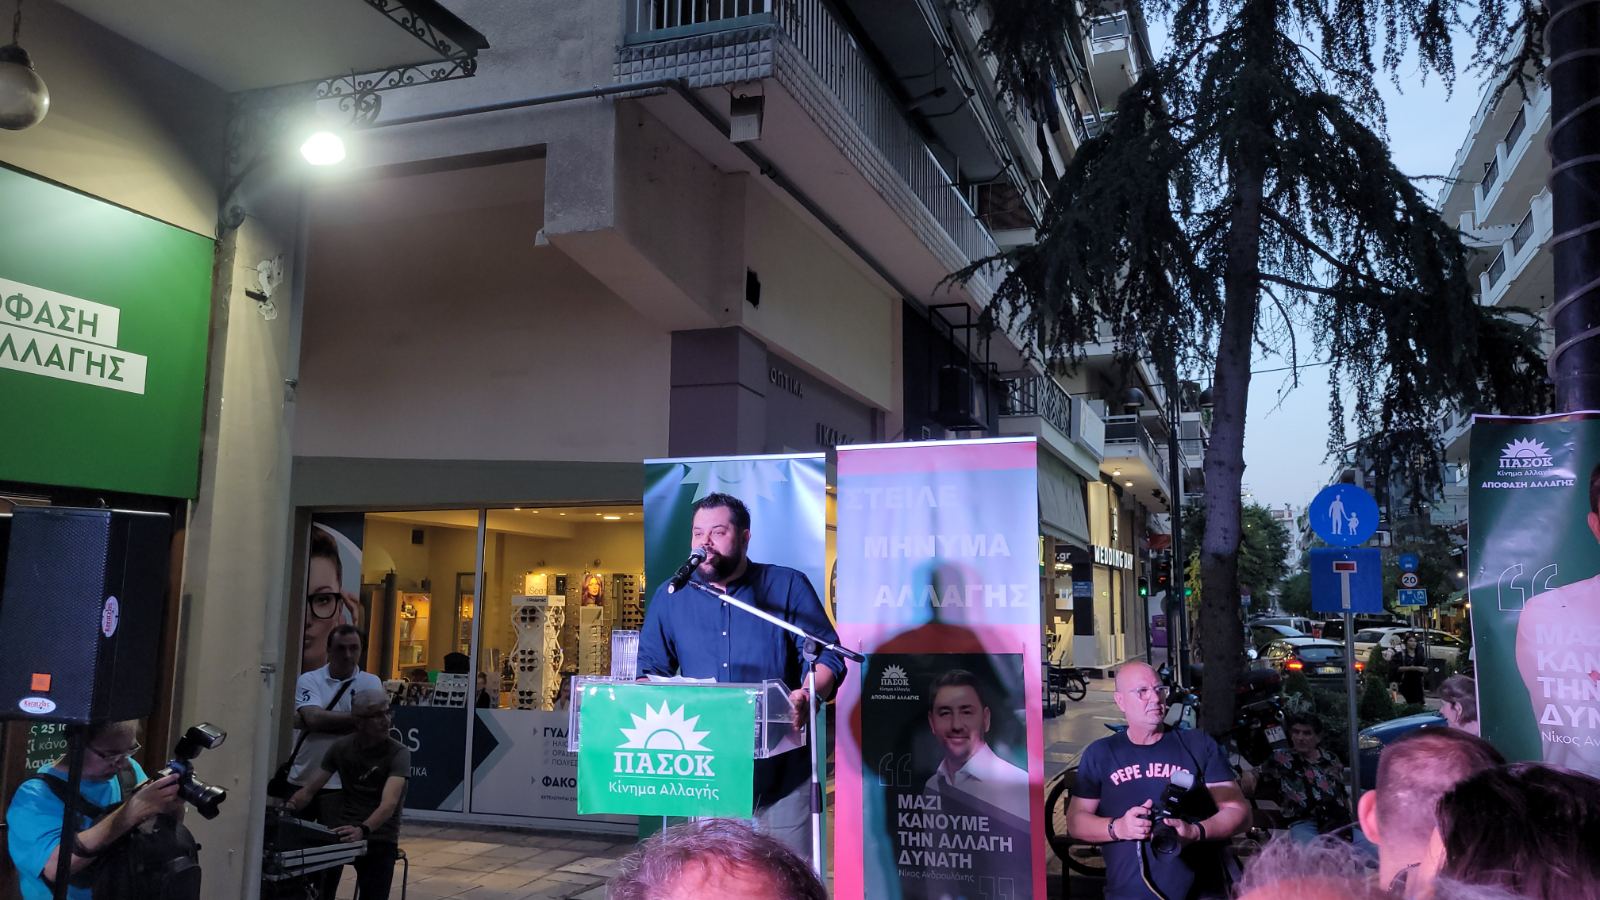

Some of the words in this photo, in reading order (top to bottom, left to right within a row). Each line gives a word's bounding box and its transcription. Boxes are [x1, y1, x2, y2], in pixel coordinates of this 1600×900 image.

[0, 292, 98, 337] ΦΑΣΗ
[1499, 457, 1553, 468] ΠΑΣΟΚ
[1482, 481, 1528, 489] ΑΠΟΦΑΣΗ
[1530, 480, 1574, 488] ΑΛΛΑΓΗΣ
[846, 485, 958, 510] ΣΤΕΙΛΕ
[864, 534, 1011, 559] ΜΗΝΥΜΑ
[1094, 545, 1123, 568] WEDDING
[1403, 576, 1416, 584] 20
[873, 584, 1030, 608] ΑΛΛΑΓΗΣ
[880, 678, 909, 686] ΠΑΣΟΚ
[1536, 676, 1600, 703] ΤΗΝ
[41, 723, 55, 734] 25
[1541, 731, 1580, 747] Νίκος
[613, 751, 715, 777] ΠΑΣΟΚ
[1110, 764, 1142, 786] PEPE
[609, 780, 656, 797] Κίνημα
[660, 782, 720, 800] Αλλαγής
[898, 794, 942, 811] ΜΑΖΙ
[898, 812, 990, 832] ΚΑΝΟΥΜΕ
[898, 831, 933, 848] ΤΗΝ
[938, 833, 1013, 853] ΑΛΛΑΓΗ
[898, 850, 972, 869] ΔΥΝΑΤΗ
[898, 869, 920, 879] Νίκος
[922, 870, 975, 883] Ανδρουλάκης
